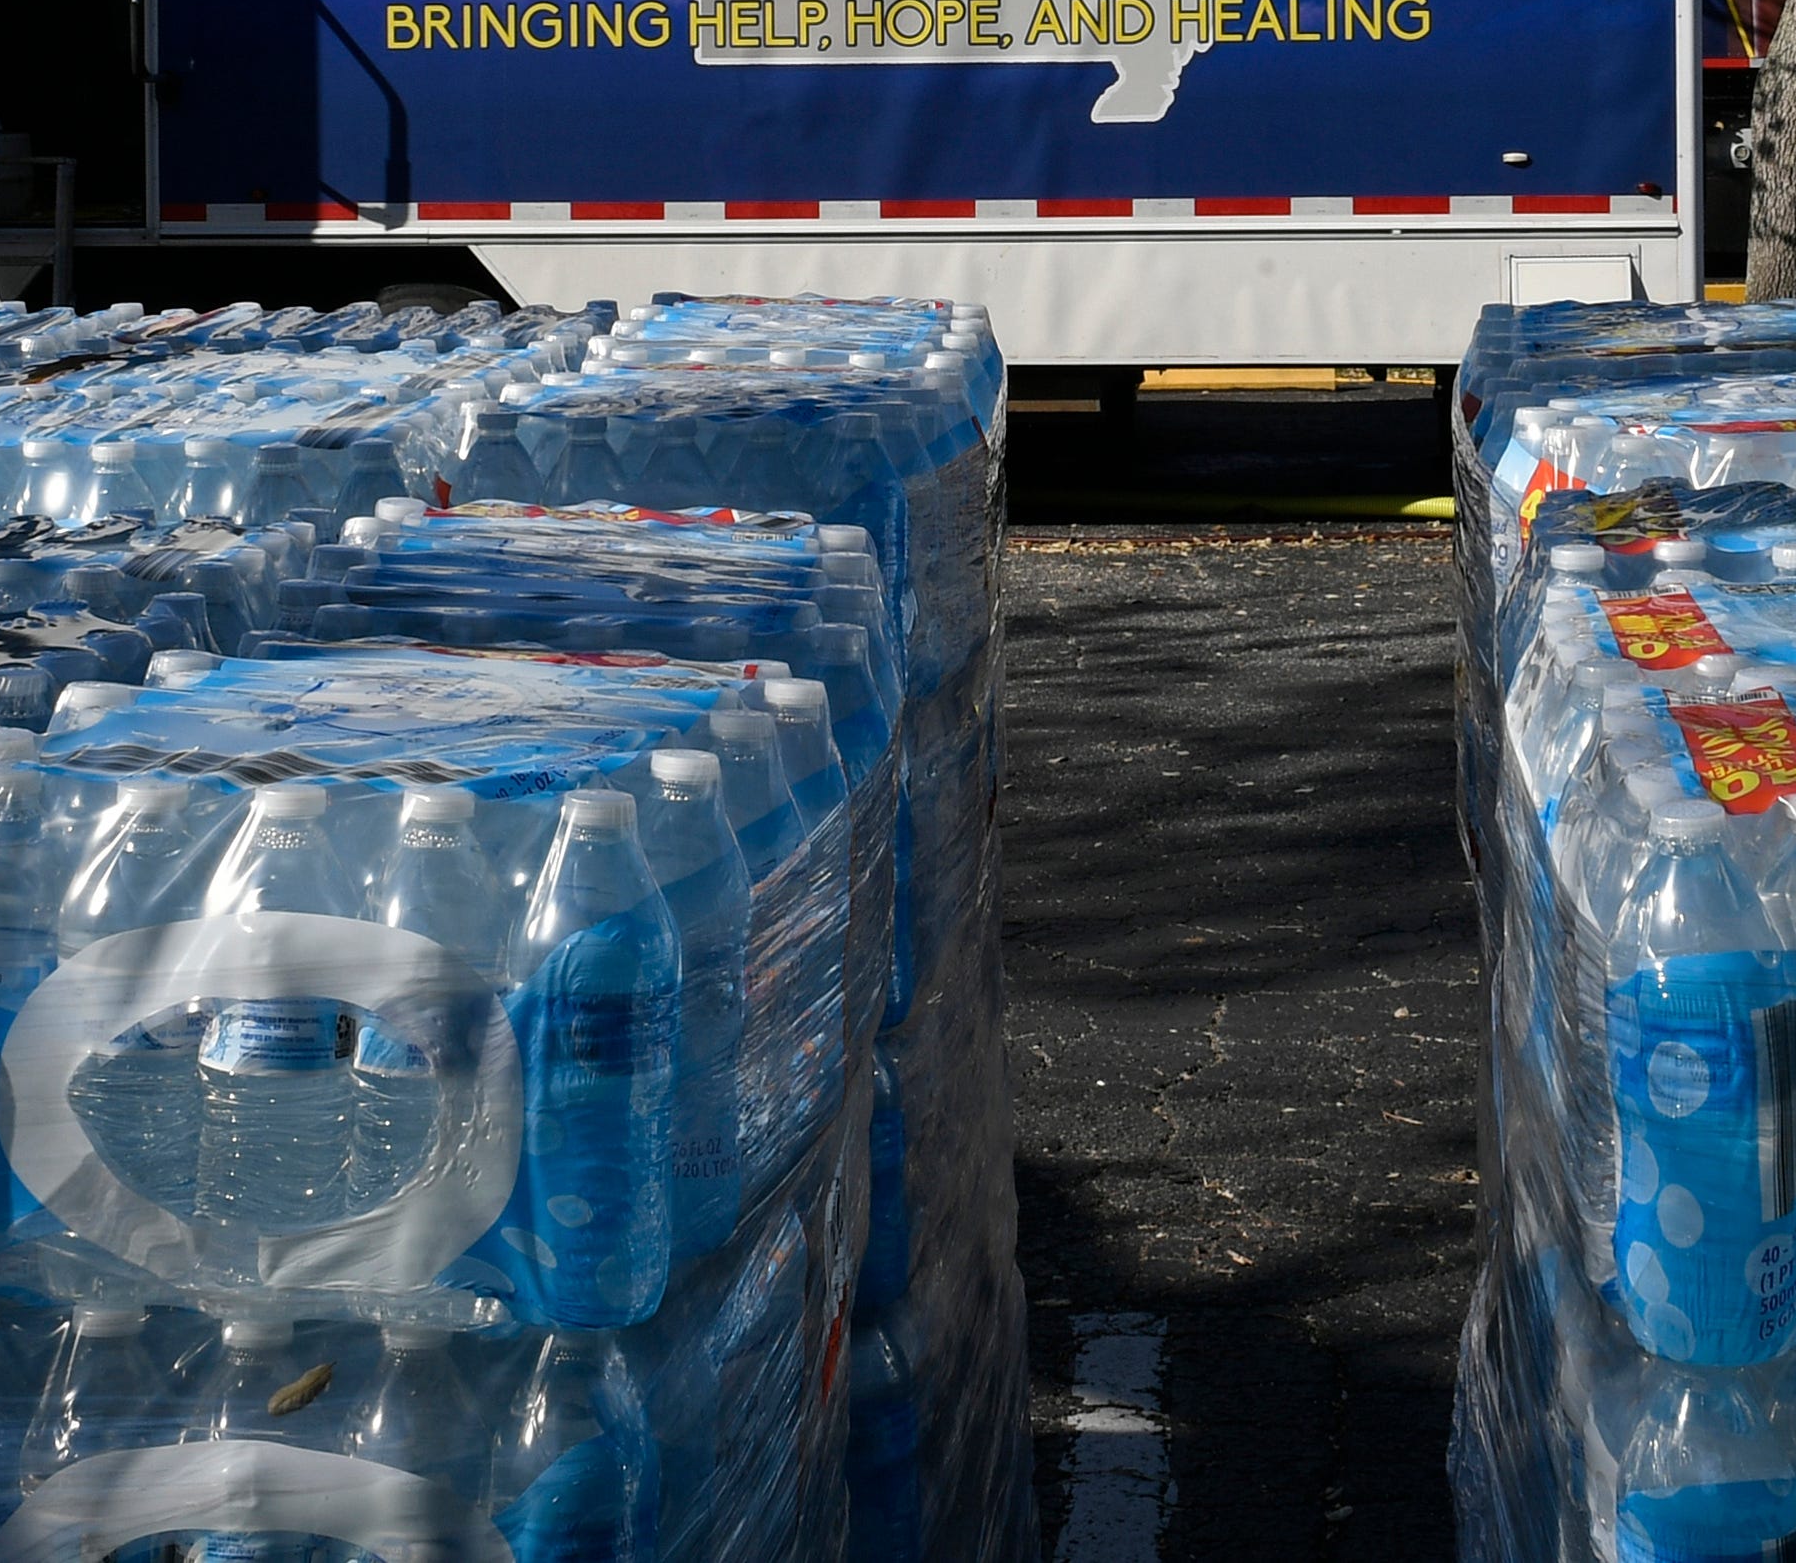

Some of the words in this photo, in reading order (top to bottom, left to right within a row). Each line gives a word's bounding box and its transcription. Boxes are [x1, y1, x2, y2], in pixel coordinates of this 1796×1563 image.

[385, 2, 672, 50] BRINGING
[689, 1, 832, 52] HELP,
[1761, 1245, 1780, 1266] 40
